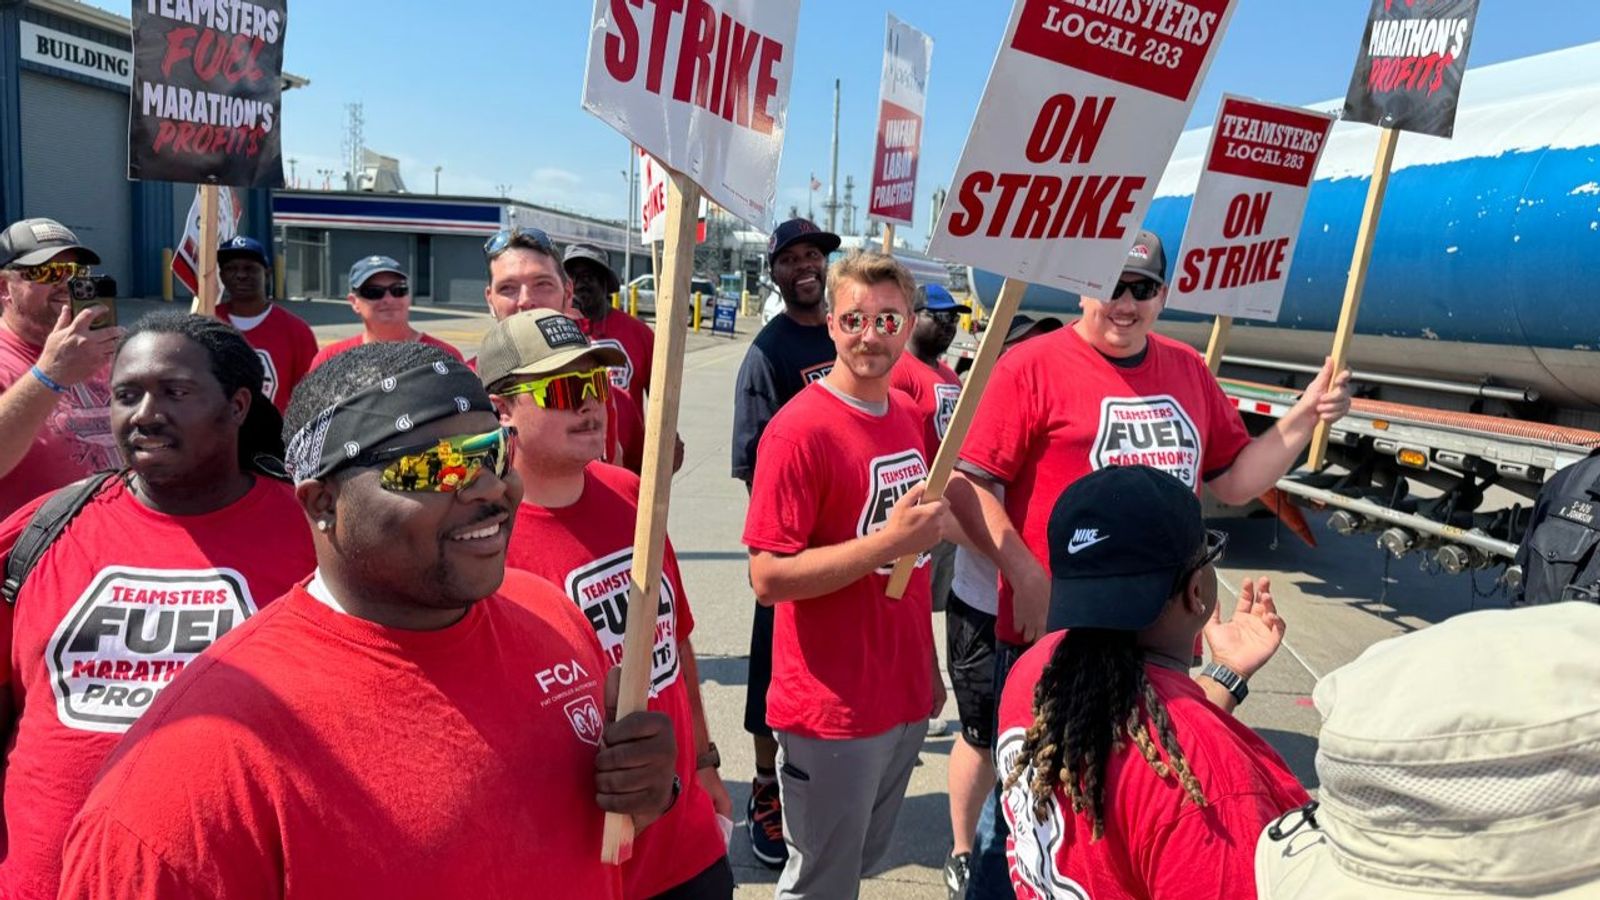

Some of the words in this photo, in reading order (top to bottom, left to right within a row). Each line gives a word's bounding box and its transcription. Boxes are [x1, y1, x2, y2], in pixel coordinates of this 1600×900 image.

[1041, 6, 1137, 57] LOCAL
[1140, 38, 1183, 69] 283
[1063, 0, 1217, 46] MSTERS
[1368, 17, 1468, 59] MARATHON'S
[36, 34, 129, 77] BUILDING
[161, 27, 265, 83] FUEL
[604, 0, 784, 136] STRIKE
[1367, 52, 1453, 94] PROFITS
[142, 81, 274, 133] MARATHON'S
[152, 121, 266, 156] PROFITS
[1025, 93, 1116, 164] ON
[1222, 114, 1323, 153] TEAMSTERS
[1225, 143, 1282, 166] LOCAL
[1282, 153, 1305, 170] 283
[947, 170, 1147, 241] STRIKE
[1223, 191, 1272, 239] ON
[1178, 237, 1289, 294] STRIKE
[1104, 419, 1195, 451] FUEL
[1113, 407, 1174, 421] TEAMSTERS
[880, 462, 924, 486] TEAMSTERS
[1108, 451, 1193, 467] MARATHON'S
[1073, 528, 1099, 542] NIKE
[112, 585, 228, 605] TEAMSTERS
[582, 568, 631, 601] TEAMST
[67, 606, 234, 654] FUEL
[584, 589, 671, 635] FUL
[72, 659, 188, 683] MARATH
[534, 659, 589, 693] FCA
